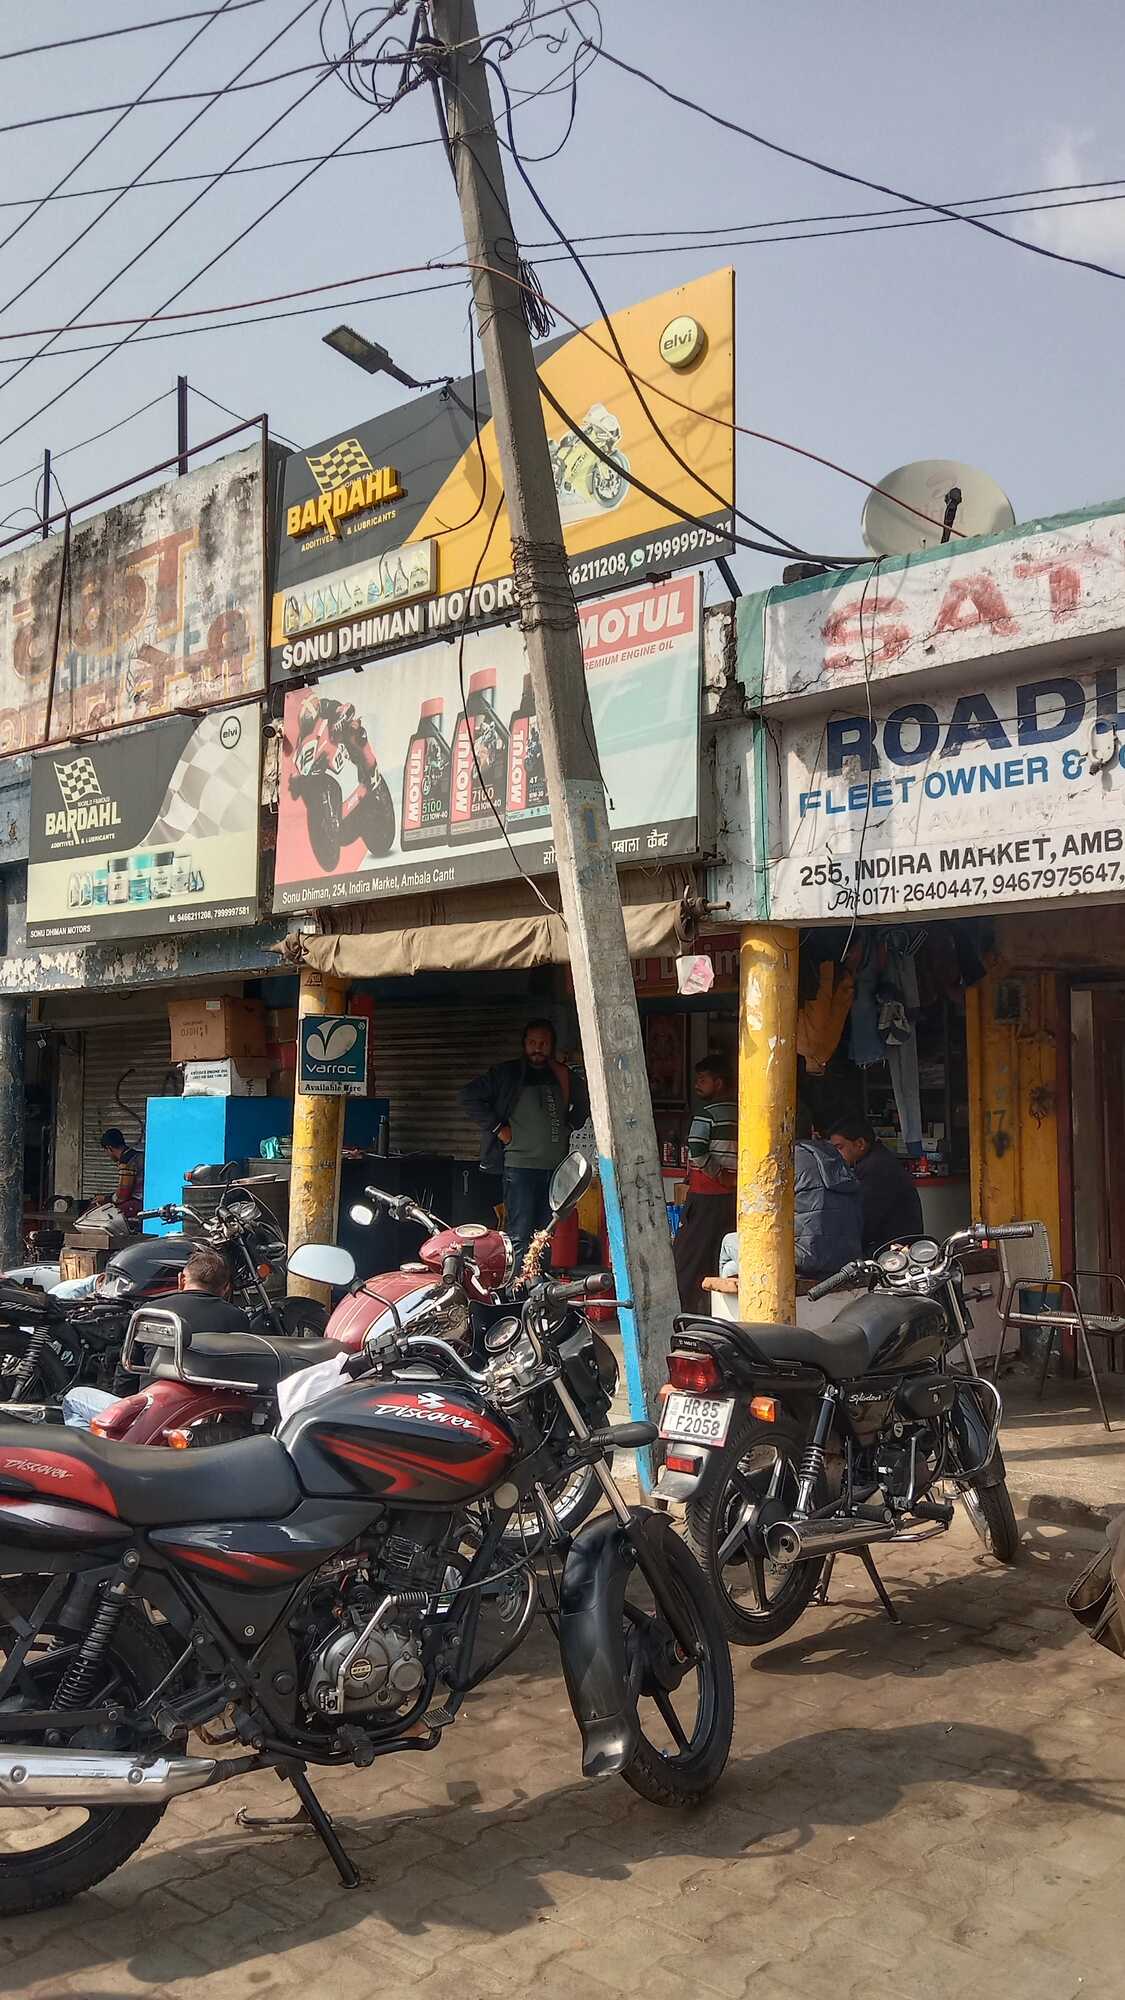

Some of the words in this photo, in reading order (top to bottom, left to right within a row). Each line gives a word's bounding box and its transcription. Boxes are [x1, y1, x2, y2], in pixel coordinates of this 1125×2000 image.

[663, 329, 692, 350] elvi
[287, 466, 400, 537] BARDAHL
[354, 510, 397, 532] LUBRICANTS
[568, 552, 629, 585] 6211208,
[281, 631, 333, 670] SONU
[339, 605, 420, 654] DHIMAN
[429, 578, 517, 627] MOTOR
[578, 590, 685, 650] MOTUL
[821, 546, 1125, 670] SAT
[584, 654, 619, 671] REMIUM
[621, 644, 656, 661] ENGINE
[659, 639, 675, 652] OIL
[223, 727, 238, 738] elvi
[455, 730, 470, 814] MOTUL
[511, 730, 523, 804] MOTUL
[408, 749, 421, 822] MOTUL
[472, 787, 495, 802] 7100
[799, 776, 916, 819] FLEET
[925, 756, 1049, 799] OWNER
[1062, 749, 1088, 780] &
[45, 801, 121, 844] BARDAHL
[422, 799, 442, 814] 5100
[800, 863, 850, 887] 255,
[854, 852, 932, 881] INDIRA
[940, 837, 1057, 872] MARKET,
[1062, 828, 1123, 858] AMB
[282, 892, 300, 905] Sonu
[302, 887, 331, 901] Dhiman,
[332, 884, 348, 898] 254,
[349, 880, 370, 894] Indira
[372, 875, 400, 891] Market,
[401, 872, 431, 887] Ambala
[433, 867, 455, 881] Cantt
[992, 861, 1125, 895] 9467975647,
[30, 929, 45, 938] SONU
[46, 927, 66, 937] DHIMAN
[67, 924, 91, 935] MOTORS
[305, 1063, 357, 1074] varroc
[305, 1083, 341, 1092] Available
[374, 1404, 481, 1431] Discover
[676, 1415, 721, 1436] F2058
[3, 1458, 73, 1480] Discover
